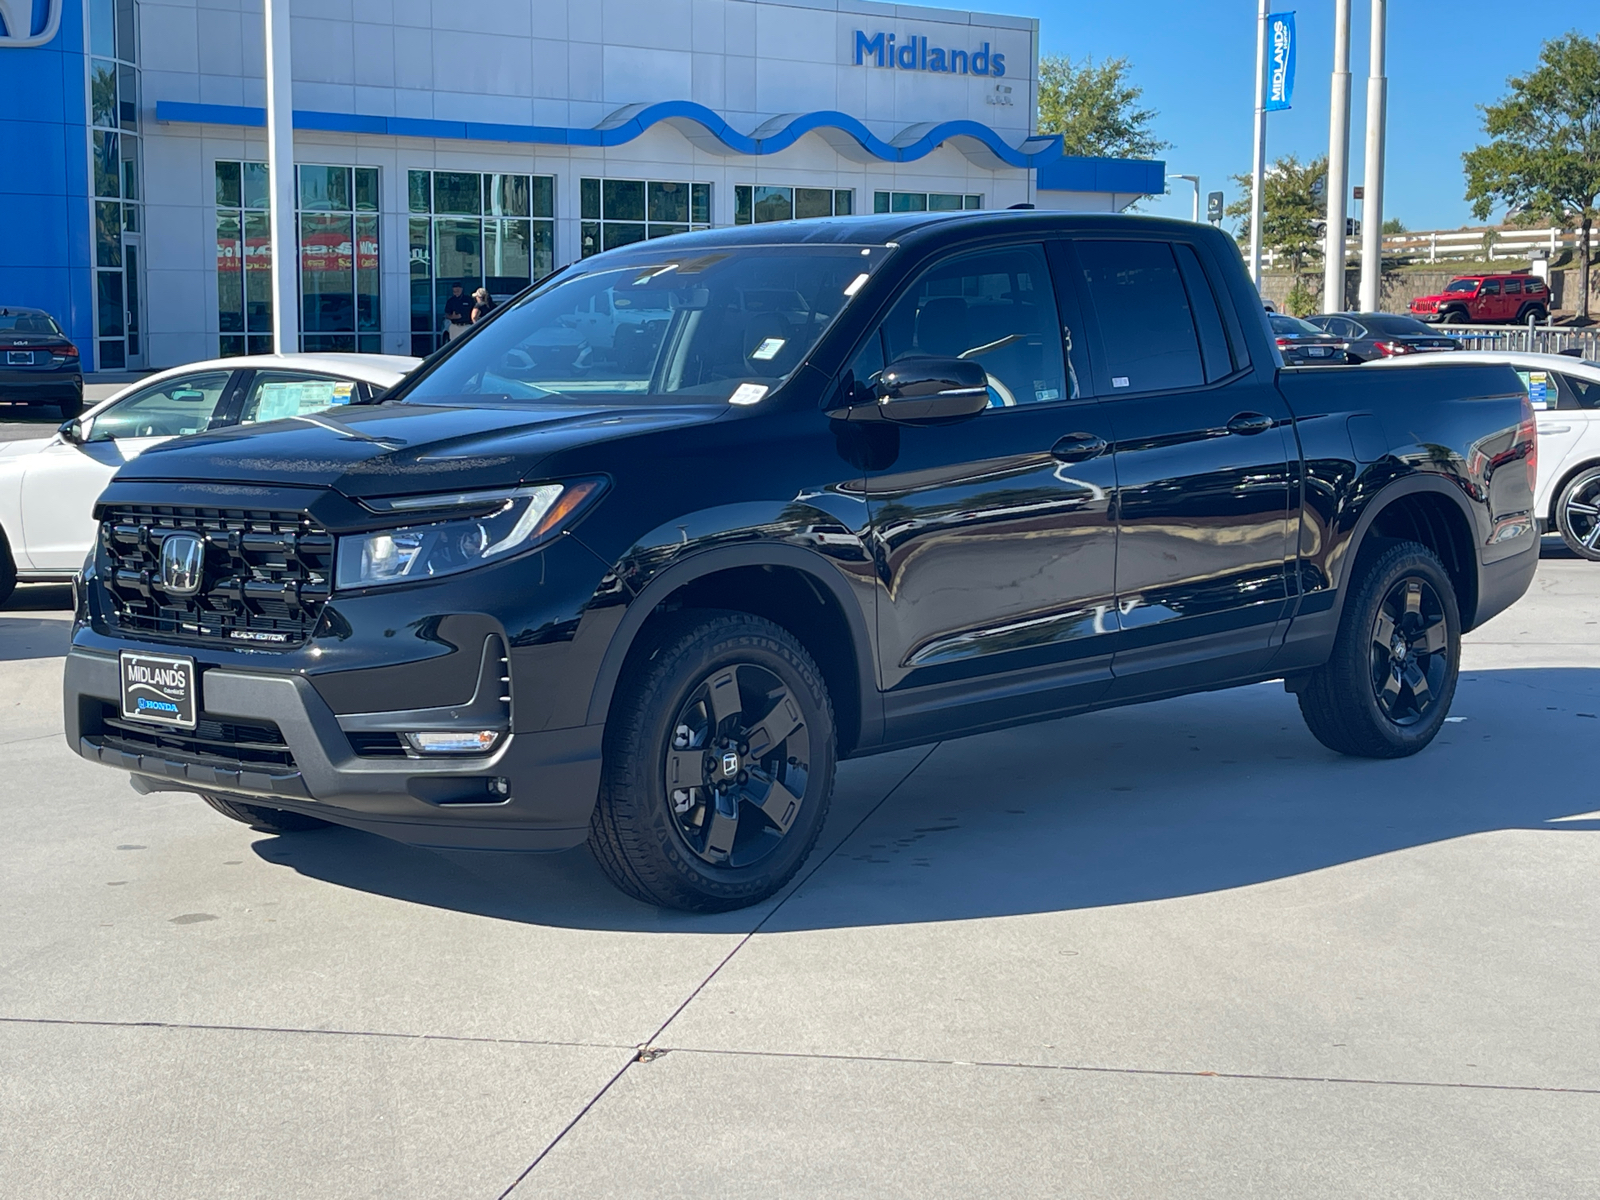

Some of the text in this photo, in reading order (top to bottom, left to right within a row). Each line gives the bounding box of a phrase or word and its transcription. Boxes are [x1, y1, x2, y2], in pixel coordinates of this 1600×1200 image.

[853, 30, 1005, 77] Midlands
[1271, 20, 1283, 101] MIDLANDS
[128, 665, 186, 688] MIDLANDS
[713, 636, 821, 699] DESTINATION
[146, 700, 179, 712] HONDA
